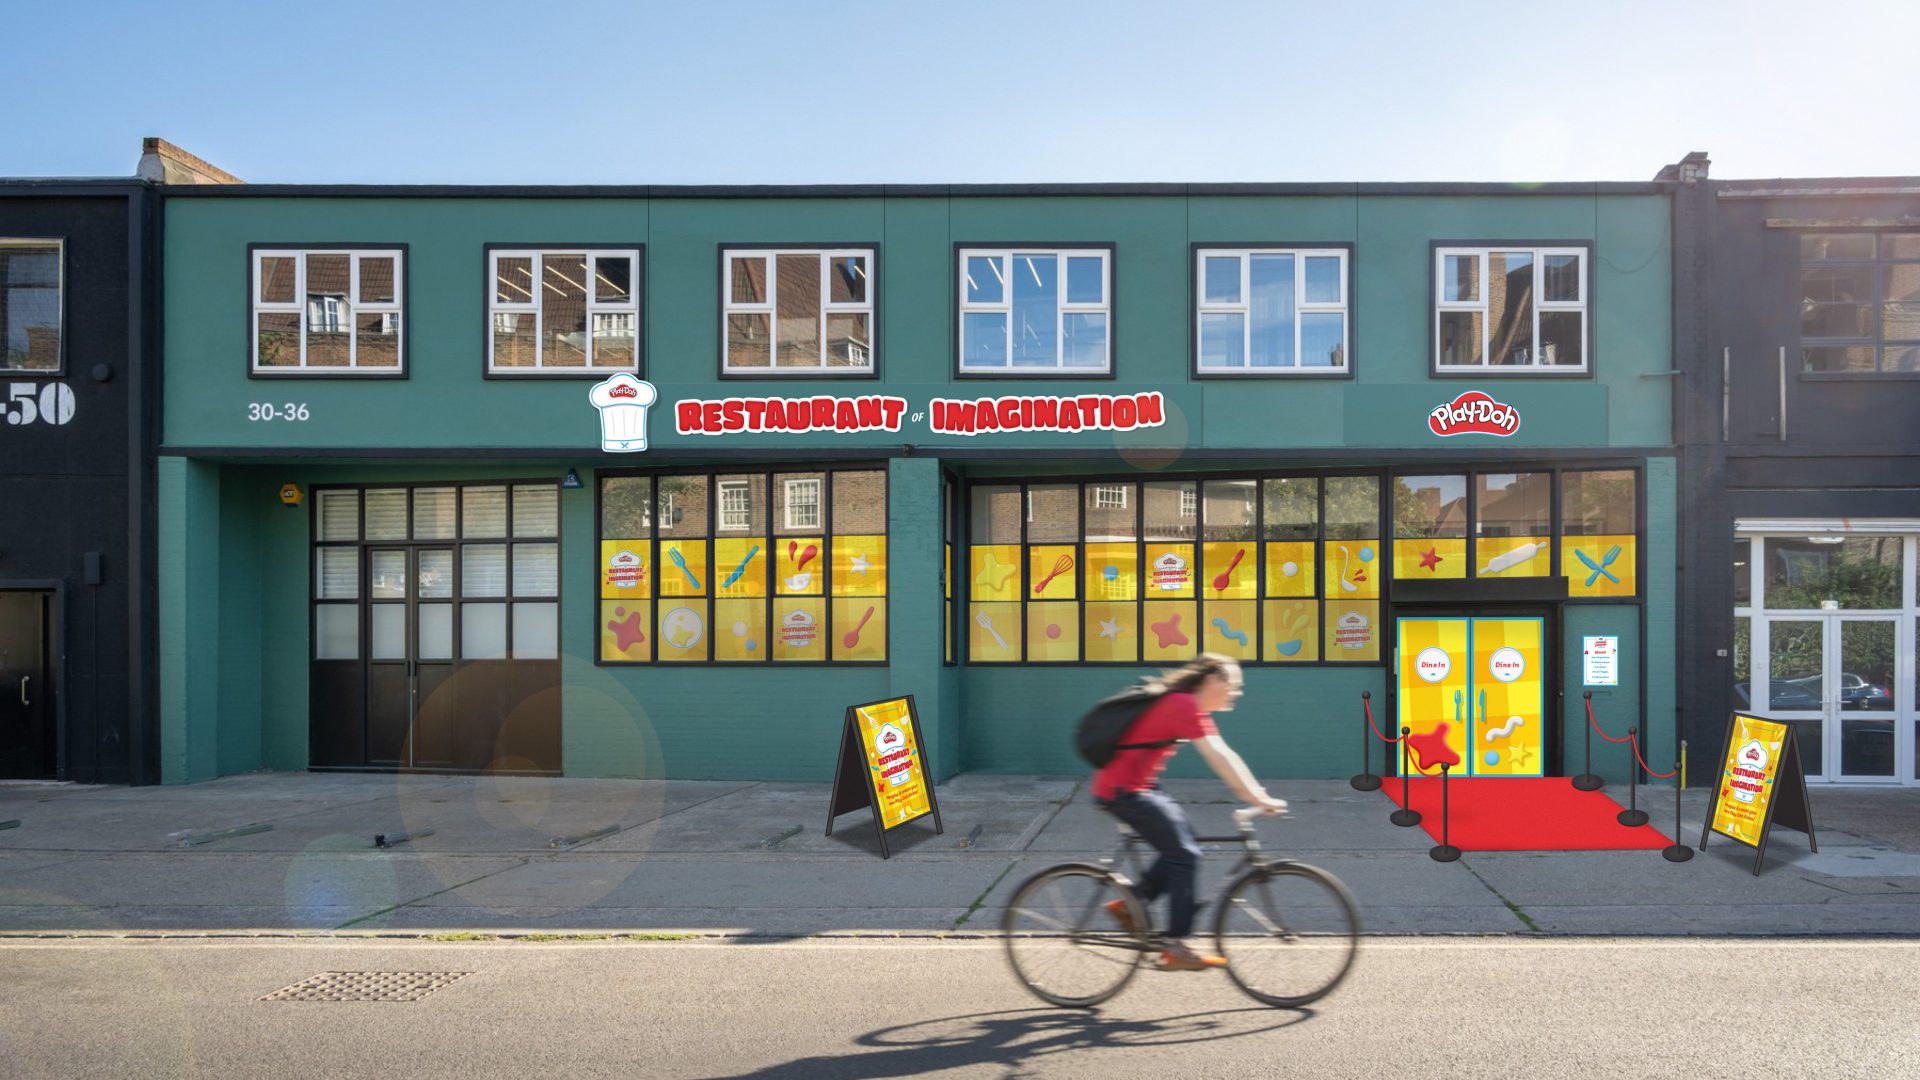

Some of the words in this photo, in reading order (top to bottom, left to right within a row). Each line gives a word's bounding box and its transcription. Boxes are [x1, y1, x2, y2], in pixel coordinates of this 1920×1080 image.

[247, 402, 310, 421] 30-36
[676, 396, 906, 434] RESTAURANT
[911, 412, 925, 423] OF
[931, 393, 1164, 434] IMAGINATION
[1431, 400, 1516, 431] Play-Doh
